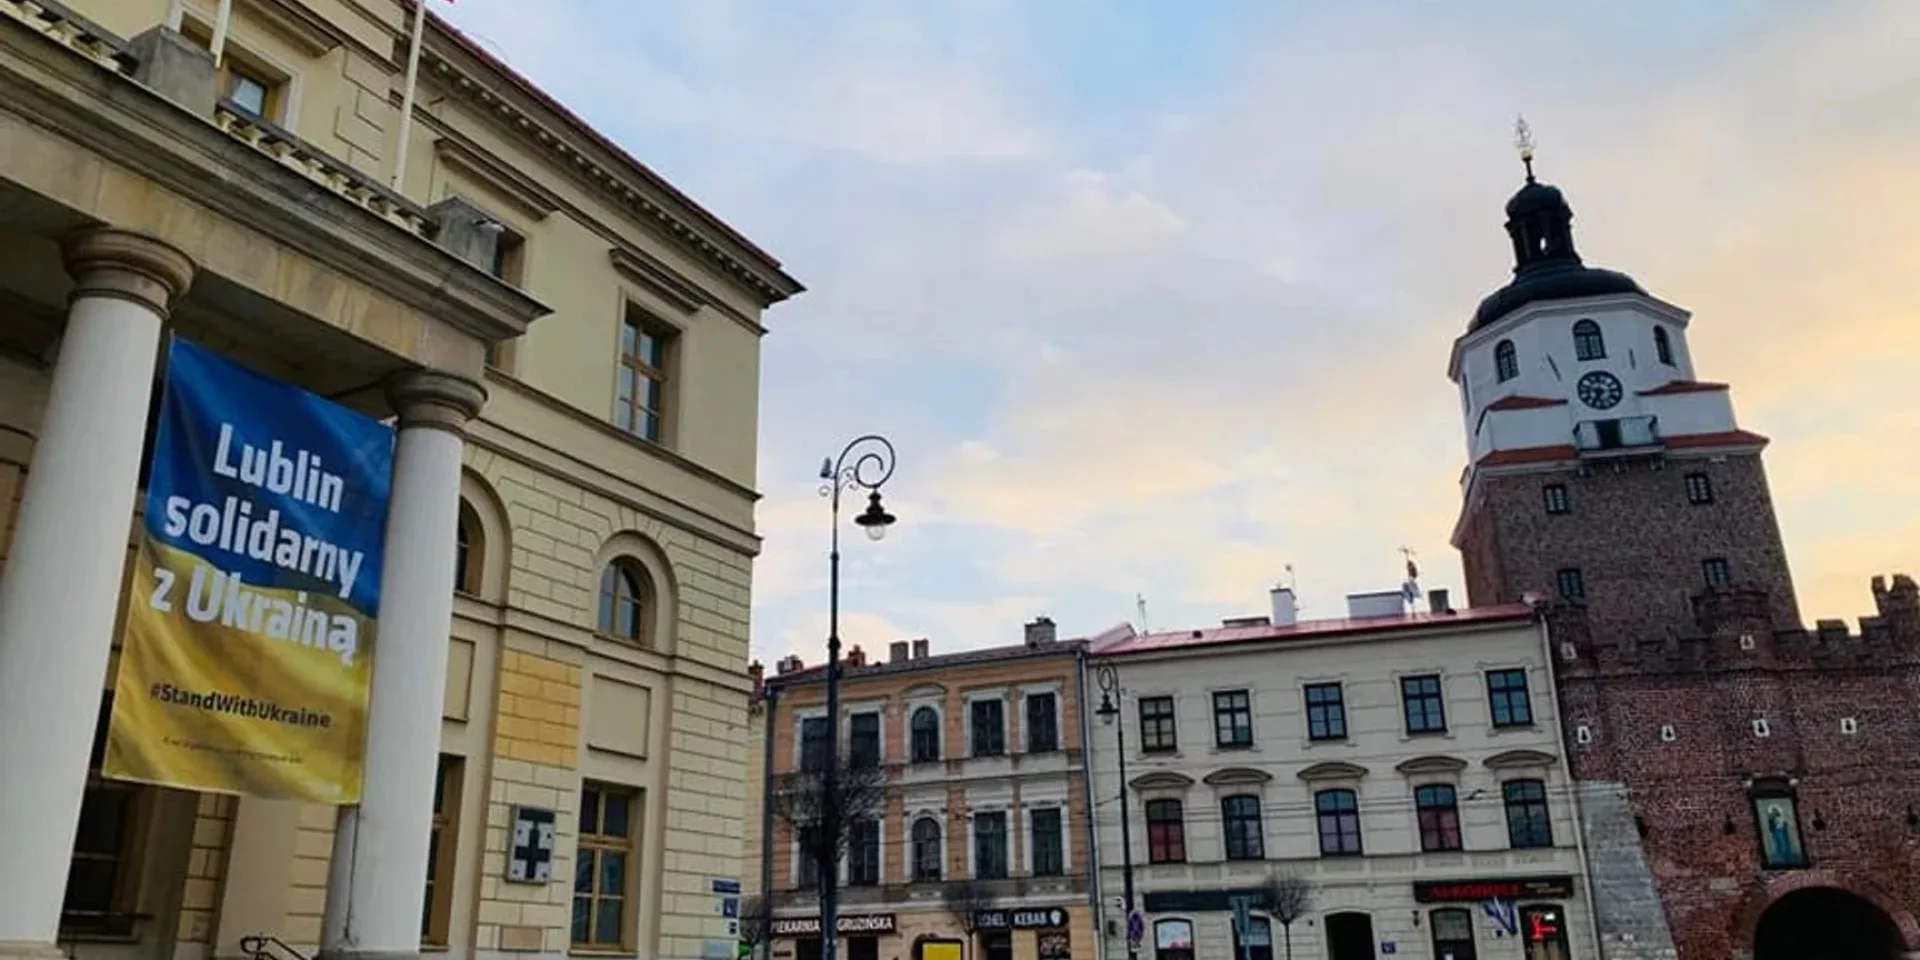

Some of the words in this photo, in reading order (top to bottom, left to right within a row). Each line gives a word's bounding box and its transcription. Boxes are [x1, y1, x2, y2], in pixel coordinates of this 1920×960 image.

[213, 422, 344, 513] Lublin
[164, 495, 364, 599] solidarny
[150, 567, 176, 612] z
[186, 565, 358, 667] Ukrainą
[151, 682, 332, 728] #StandWithUkraine
[1014, 911, 1047, 925] KEBAB
